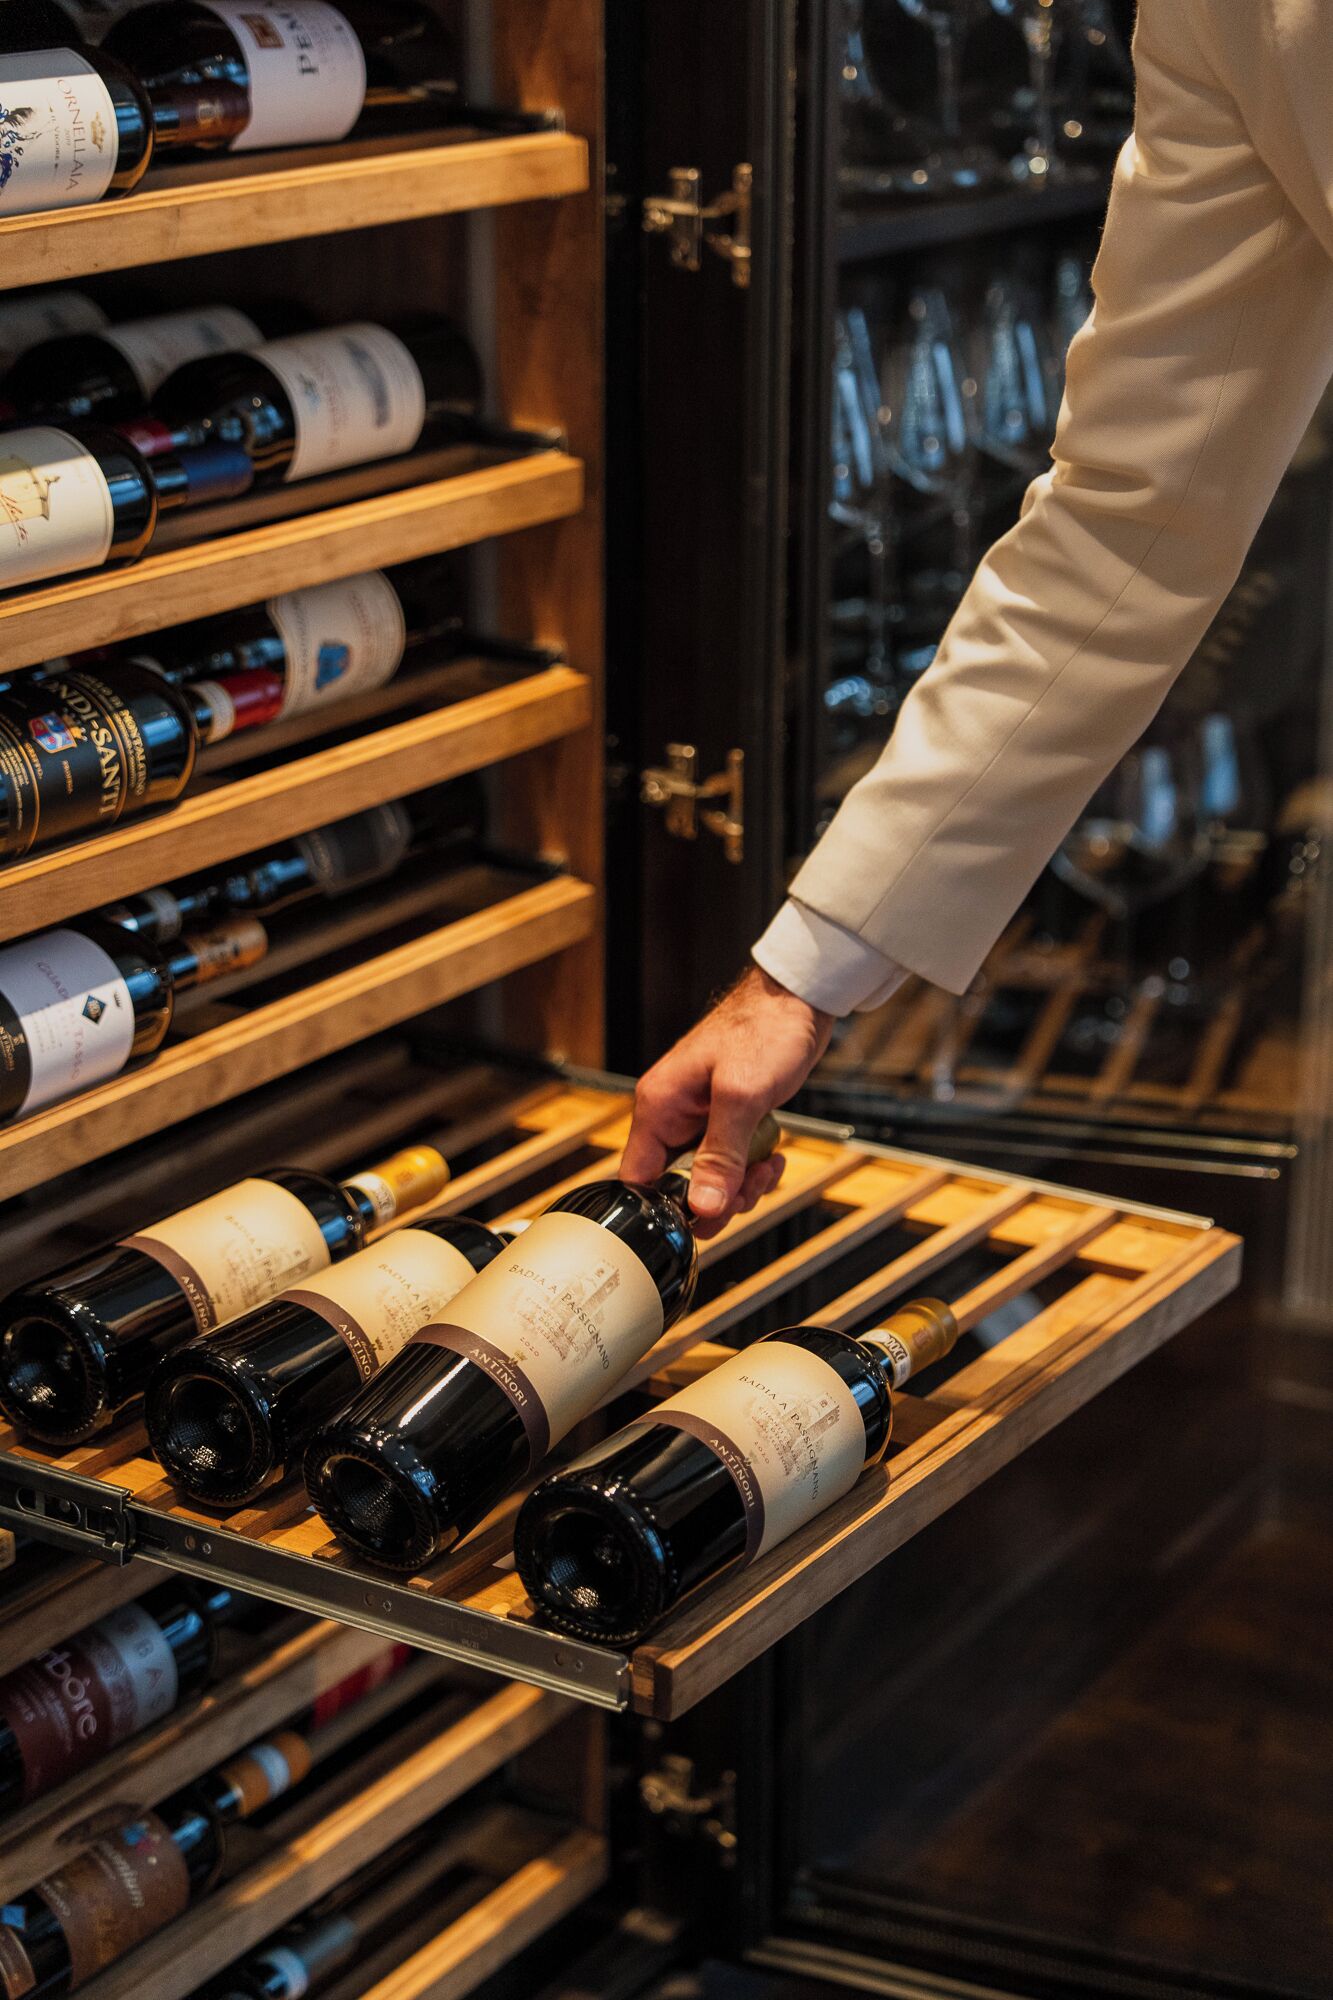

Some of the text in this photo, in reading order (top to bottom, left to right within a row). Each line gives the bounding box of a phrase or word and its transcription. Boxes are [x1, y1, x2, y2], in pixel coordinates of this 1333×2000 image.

[57, 79, 86, 191] ORNELLAIA
[181, 1275, 209, 1329] ANTINO
[378, 1263, 412, 1291] BADIA
[508, 1264, 610, 1370] BADIA A PASSIGNANO
[338, 1323, 371, 1379] ANTINO
[470, 1347, 528, 1407] ANTINORI
[738, 1375, 821, 1501] BADIA A PASSIGNANO
[709, 1438, 755, 1508] ANTINORI
